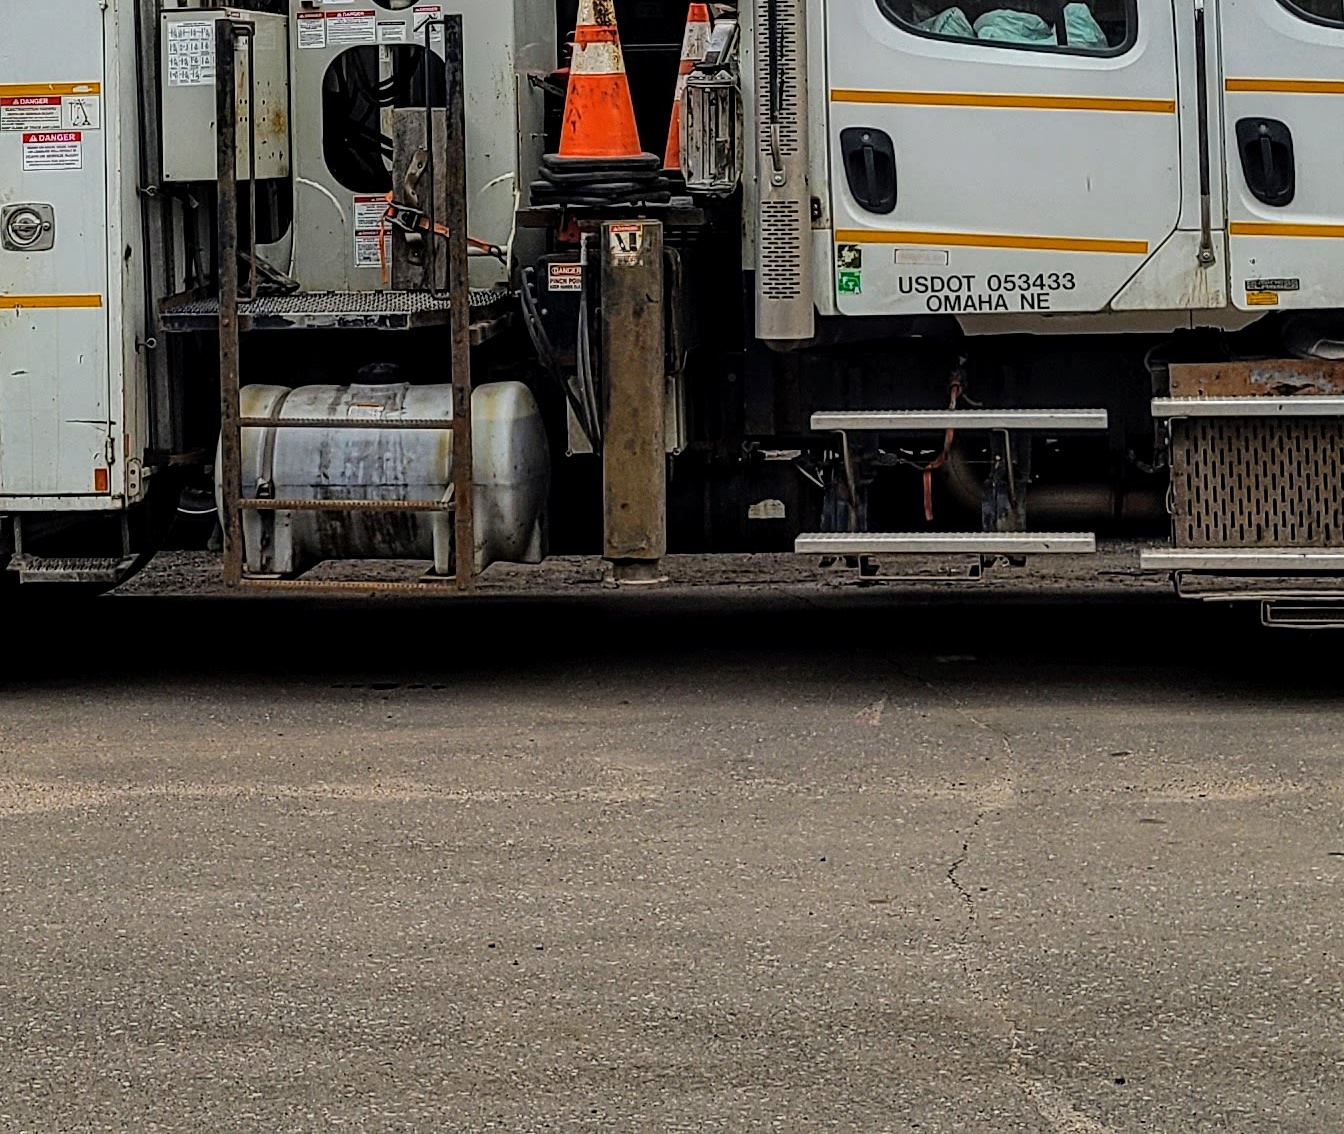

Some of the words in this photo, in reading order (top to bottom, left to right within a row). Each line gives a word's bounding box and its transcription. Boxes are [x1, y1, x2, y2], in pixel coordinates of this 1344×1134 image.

[19, 97, 49, 105] DANGER
[39, 133, 76, 142] DANGER
[898, 275, 976, 294] USDOT
[987, 272, 1076, 292] 053433
[926, 293, 1009, 312] OMAHA
[1020, 292, 1051, 310] NE
